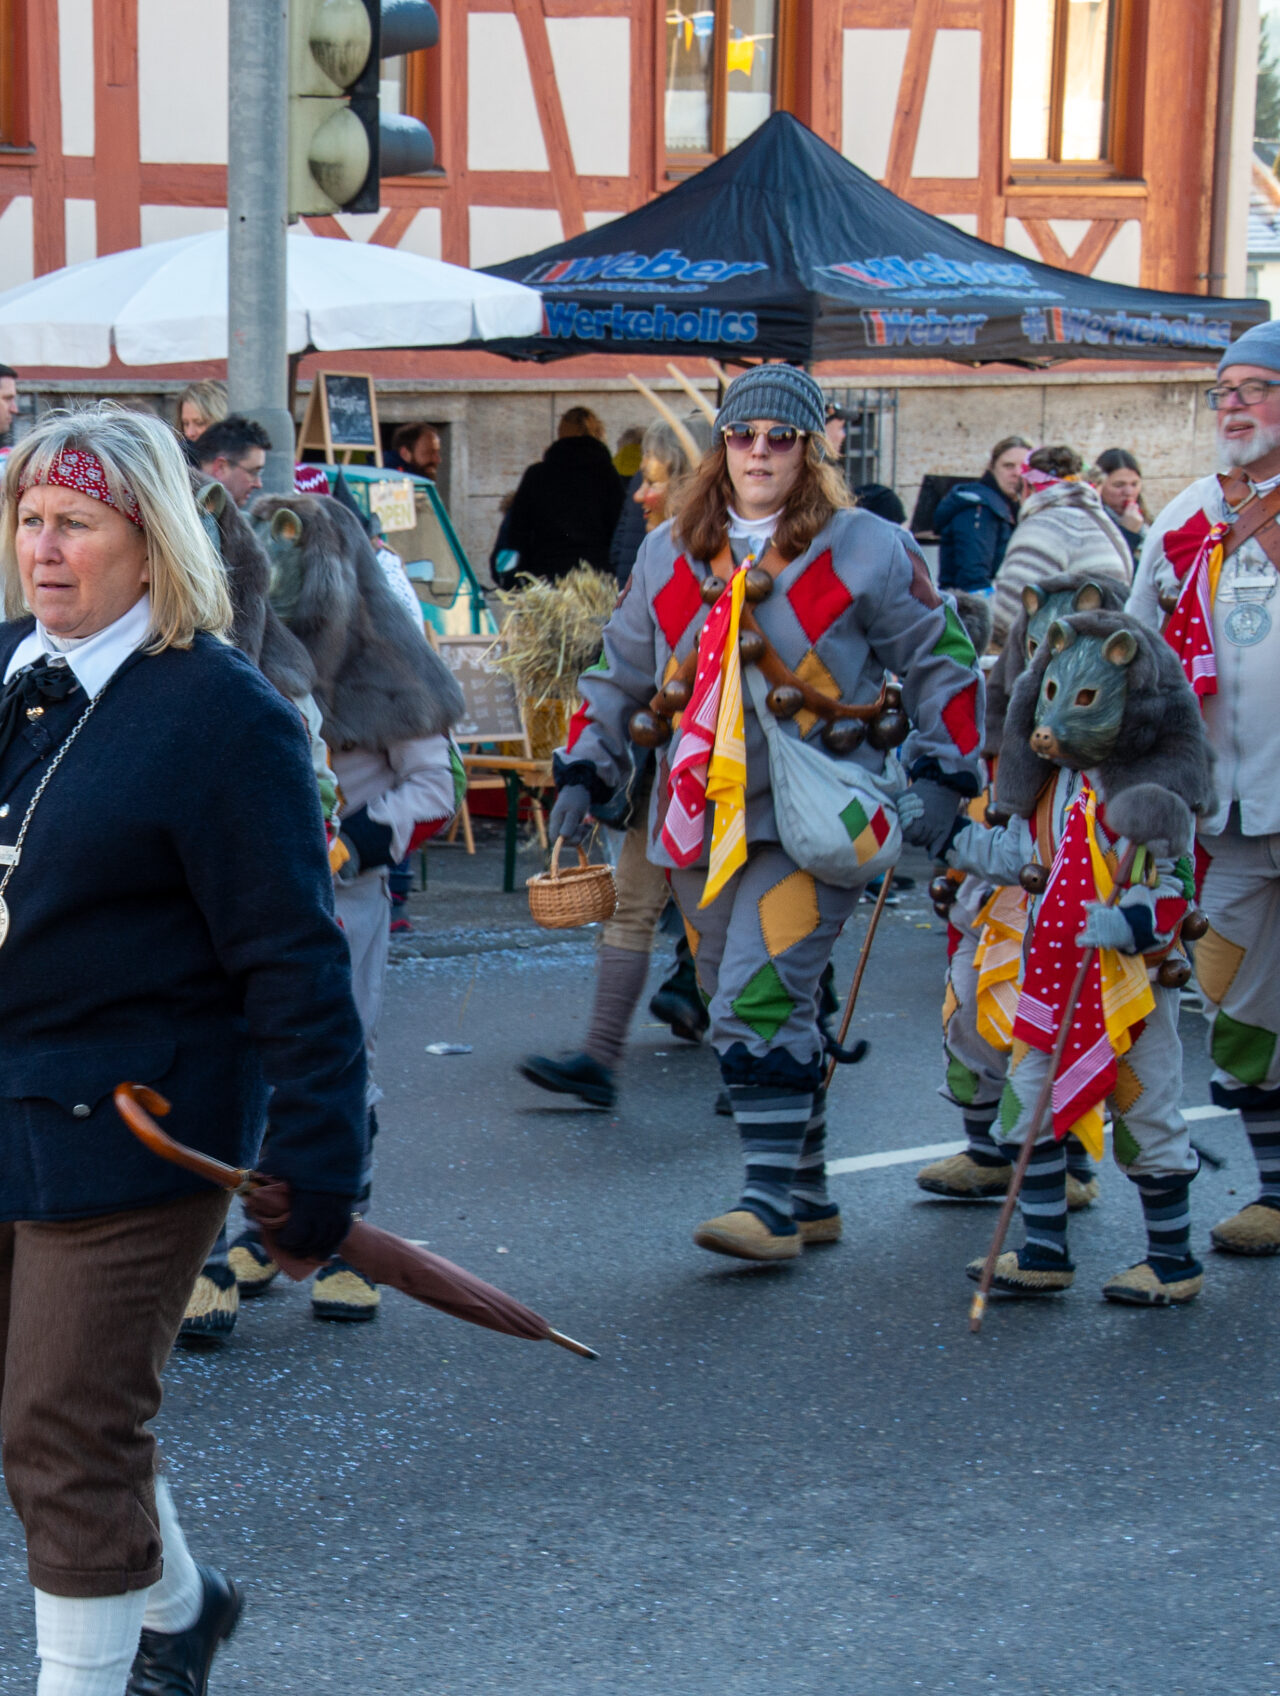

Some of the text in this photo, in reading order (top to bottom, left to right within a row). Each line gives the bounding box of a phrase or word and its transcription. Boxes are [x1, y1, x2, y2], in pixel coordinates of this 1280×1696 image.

[561, 249, 768, 283] Weber
[846, 252, 1040, 287] Weber
[544, 302, 758, 343] Werkeholics
[881, 308, 988, 346] Weber
